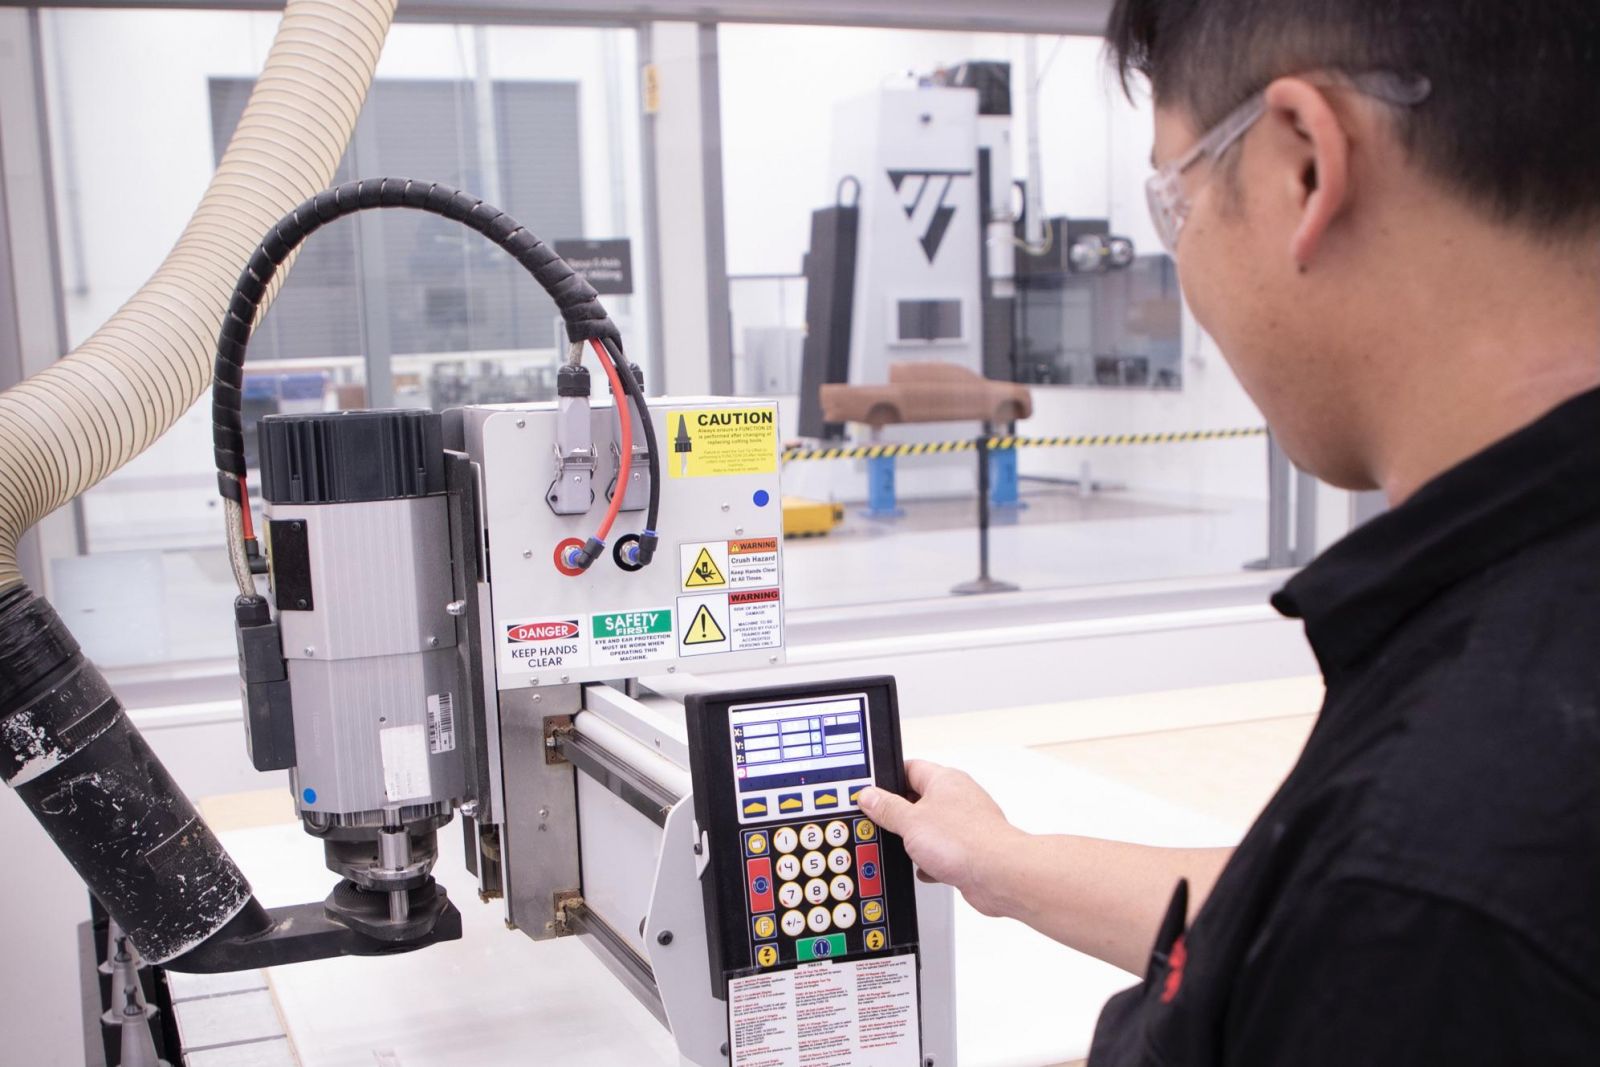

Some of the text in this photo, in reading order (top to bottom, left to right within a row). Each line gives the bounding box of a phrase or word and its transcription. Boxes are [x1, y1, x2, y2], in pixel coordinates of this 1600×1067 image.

[698, 412, 772, 426] CAUTION
[740, 542, 776, 550] WARNING
[731, 592, 778, 601] WARNING
[605, 613, 659, 630] SAFETY
[519, 626, 568, 639] DANGER
[616, 626, 648, 635] FIRST
[512, 645, 578, 658] KEEP HANDS
[528, 657, 562, 668] CLEAR
[737, 755, 745, 763] Z:
[808, 832, 816, 842] 2
[834, 829, 841, 839] 3
[810, 859, 818, 869] 5
[835, 856, 844, 865] 6
[784, 862, 793, 872] 4
[813, 886, 821, 896] 8
[837, 882, 846, 891] 9
[787, 890, 795, 900] 7
[815, 914, 823, 924] 0
[761, 921, 770, 934] F
